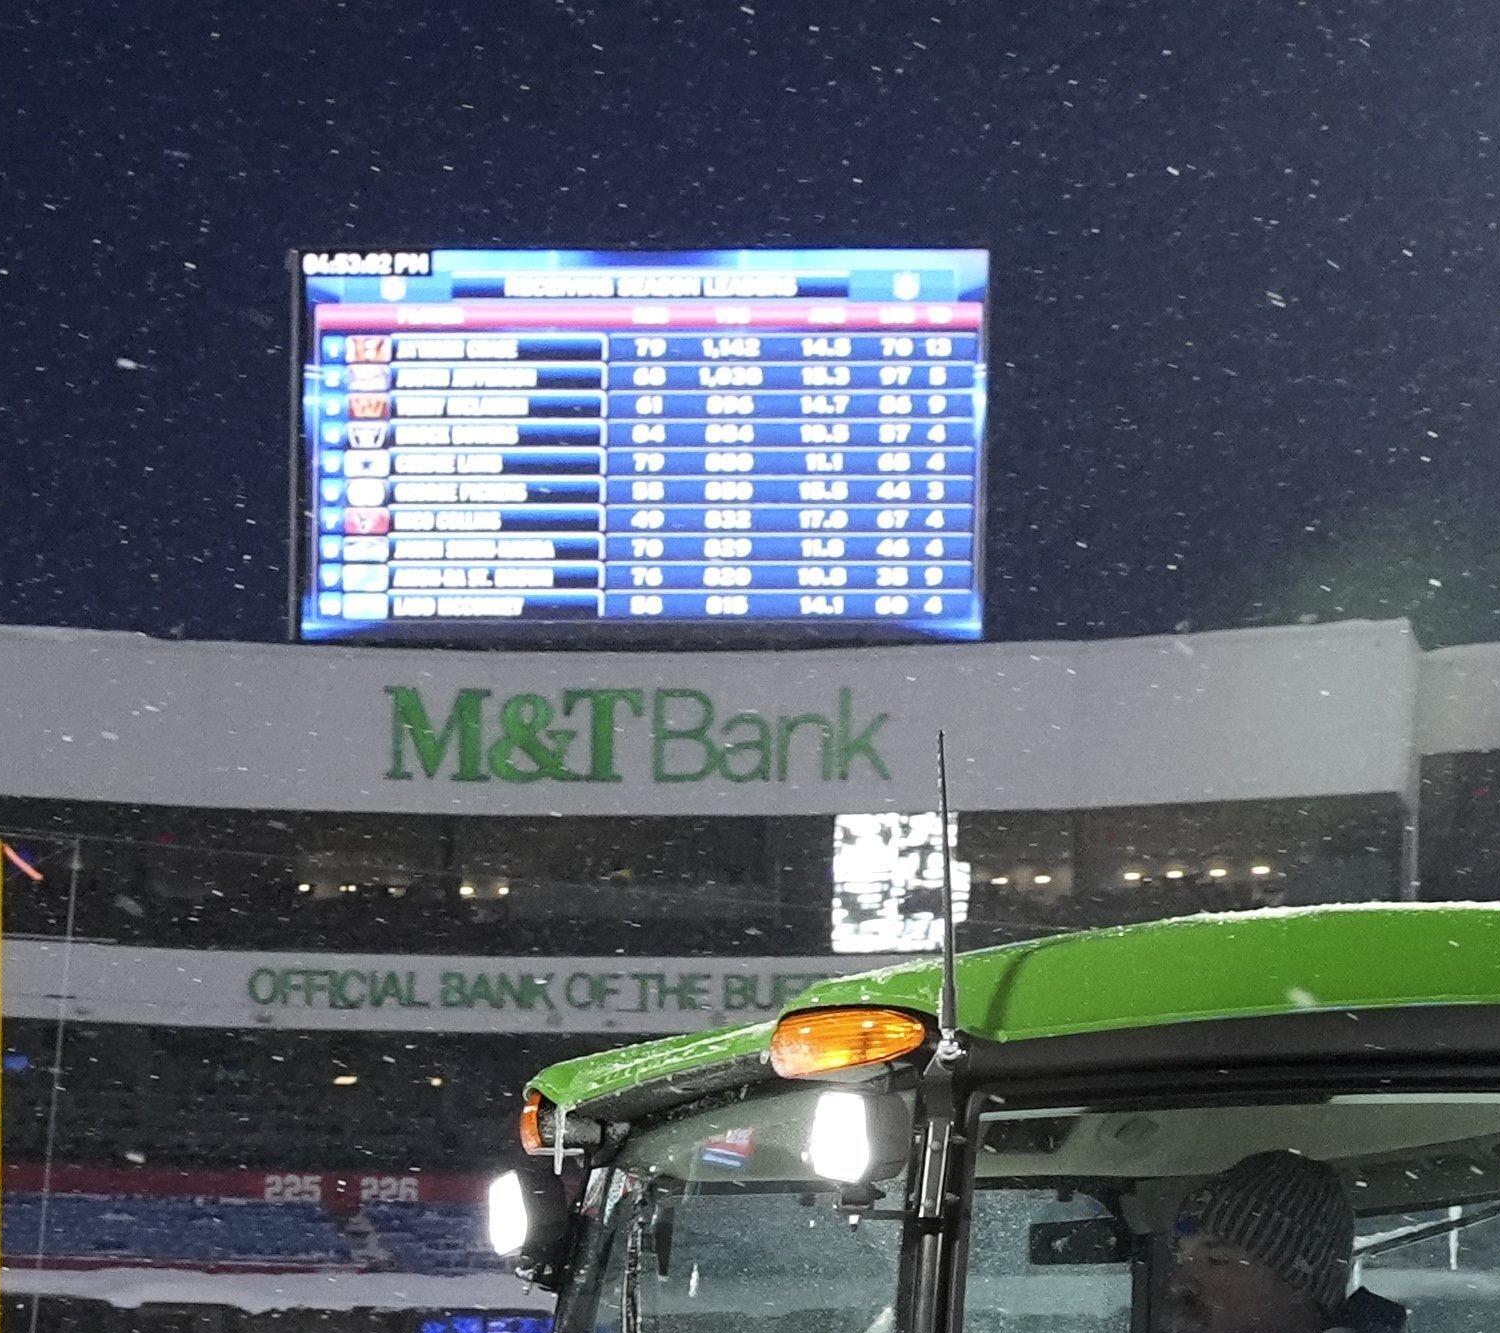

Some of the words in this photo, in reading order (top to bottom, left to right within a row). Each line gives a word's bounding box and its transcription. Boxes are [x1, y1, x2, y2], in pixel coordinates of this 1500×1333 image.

[928, 422, 946, 442] 4
[927, 451, 945, 471] 4
[926, 510, 944, 528] 4
[925, 539, 943, 557] 4
[925, 567, 943, 590] 9
[924, 596, 942, 614] 4
[248, 967, 430, 1010] OFFICIAL
[443, 971, 555, 1011] BANK
[566, 973, 621, 1012] OF
[630, 974, 712, 1011] THE
[264, 1174, 322, 1202] 225
[361, 1175, 420, 1202] 226
